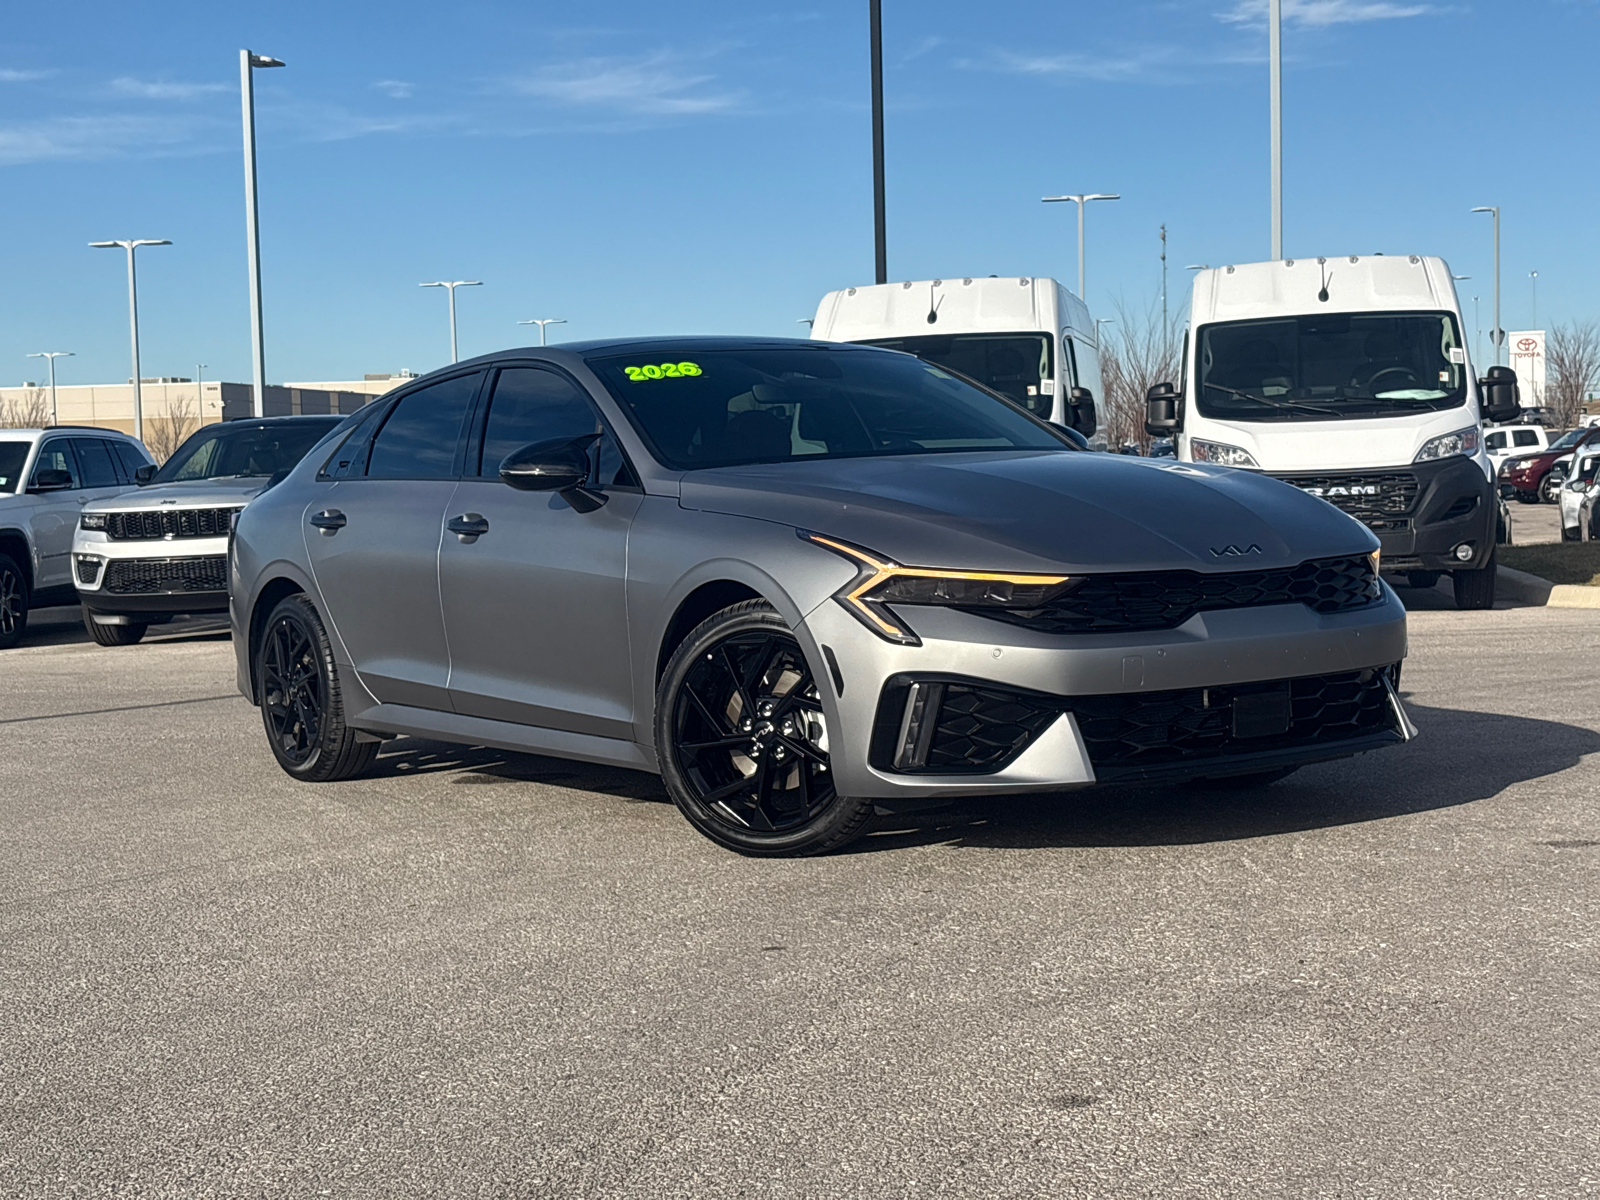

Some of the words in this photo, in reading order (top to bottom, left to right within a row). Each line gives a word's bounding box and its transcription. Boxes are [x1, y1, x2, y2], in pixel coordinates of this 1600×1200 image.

[624, 362, 702, 381] 2026
[1301, 485, 1375, 497] RAM
[1209, 543, 1262, 558] KIA
